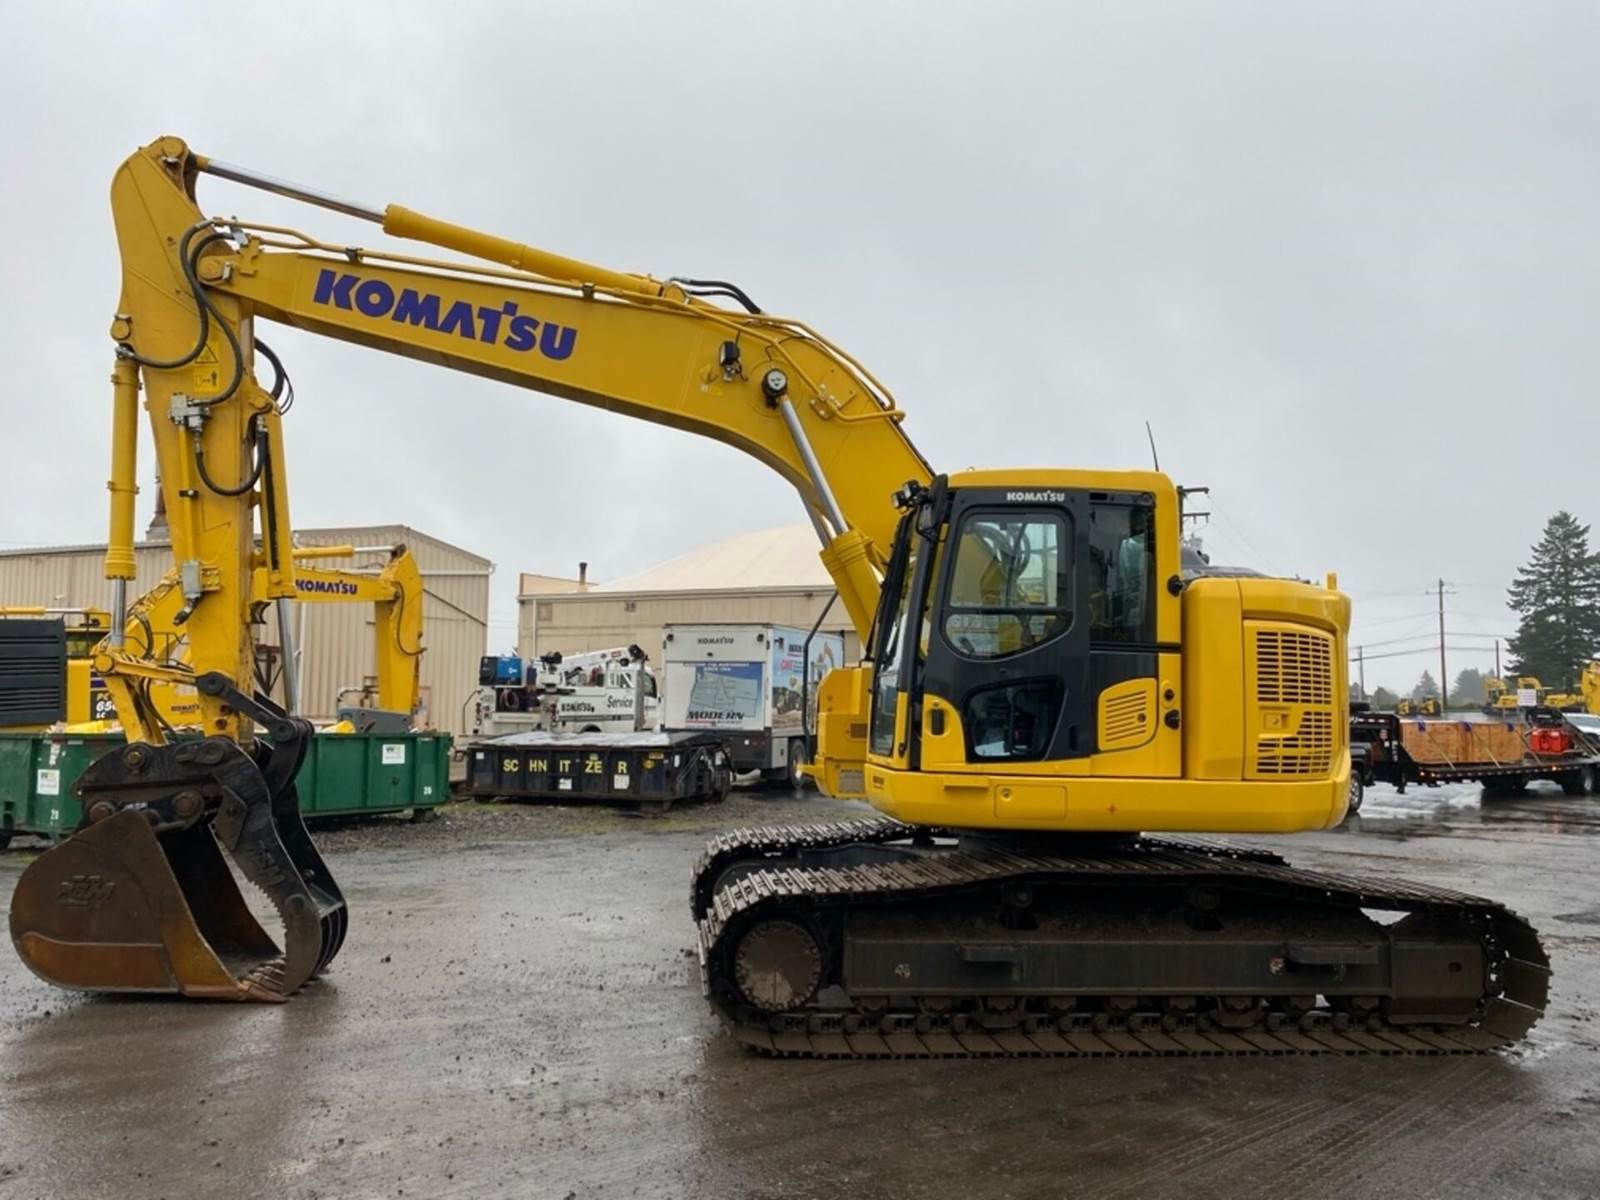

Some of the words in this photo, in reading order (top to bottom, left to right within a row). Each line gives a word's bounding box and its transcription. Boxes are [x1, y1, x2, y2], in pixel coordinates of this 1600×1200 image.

[313, 268, 578, 361] KOMATSU
[1007, 490, 1065, 502] KOMATSU
[295, 579, 358, 595] KOMATSU
[698, 636, 734, 644] KOMATSU
[607, 695, 633, 708] Service
[688, 711, 745, 720] MODERN
